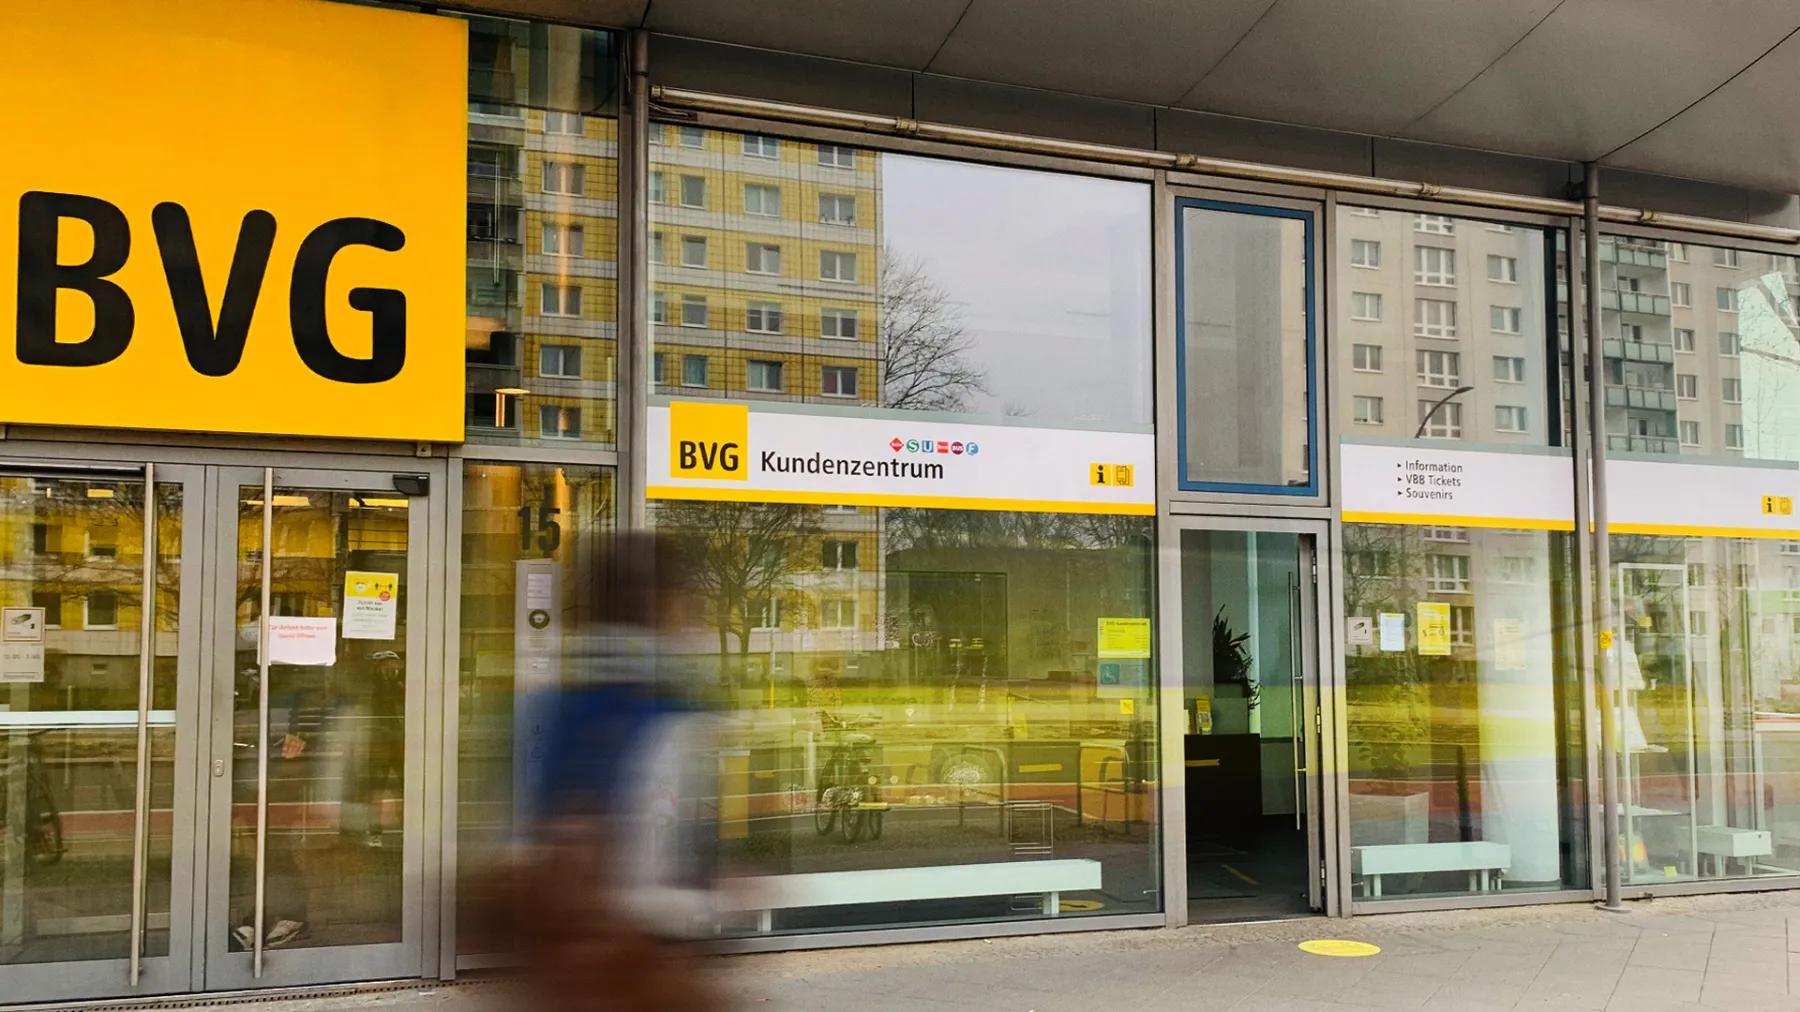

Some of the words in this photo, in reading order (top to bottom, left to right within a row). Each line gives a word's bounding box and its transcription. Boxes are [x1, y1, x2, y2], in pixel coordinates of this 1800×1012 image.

[15, 190, 407, 384] BVG
[679, 440, 739, 472] BVG
[907, 440, 919, 452] S
[922, 440, 934, 452] U
[952, 444, 964, 452] BUS
[761, 450, 944, 479] Kundenzentrum
[1405, 459, 1463, 473] Information
[1405, 473, 1426, 485] VBB
[1428, 474, 1462, 487] Tickets
[1405, 487, 1453, 500] Souvenirs
[517, 506, 561, 552] 15
